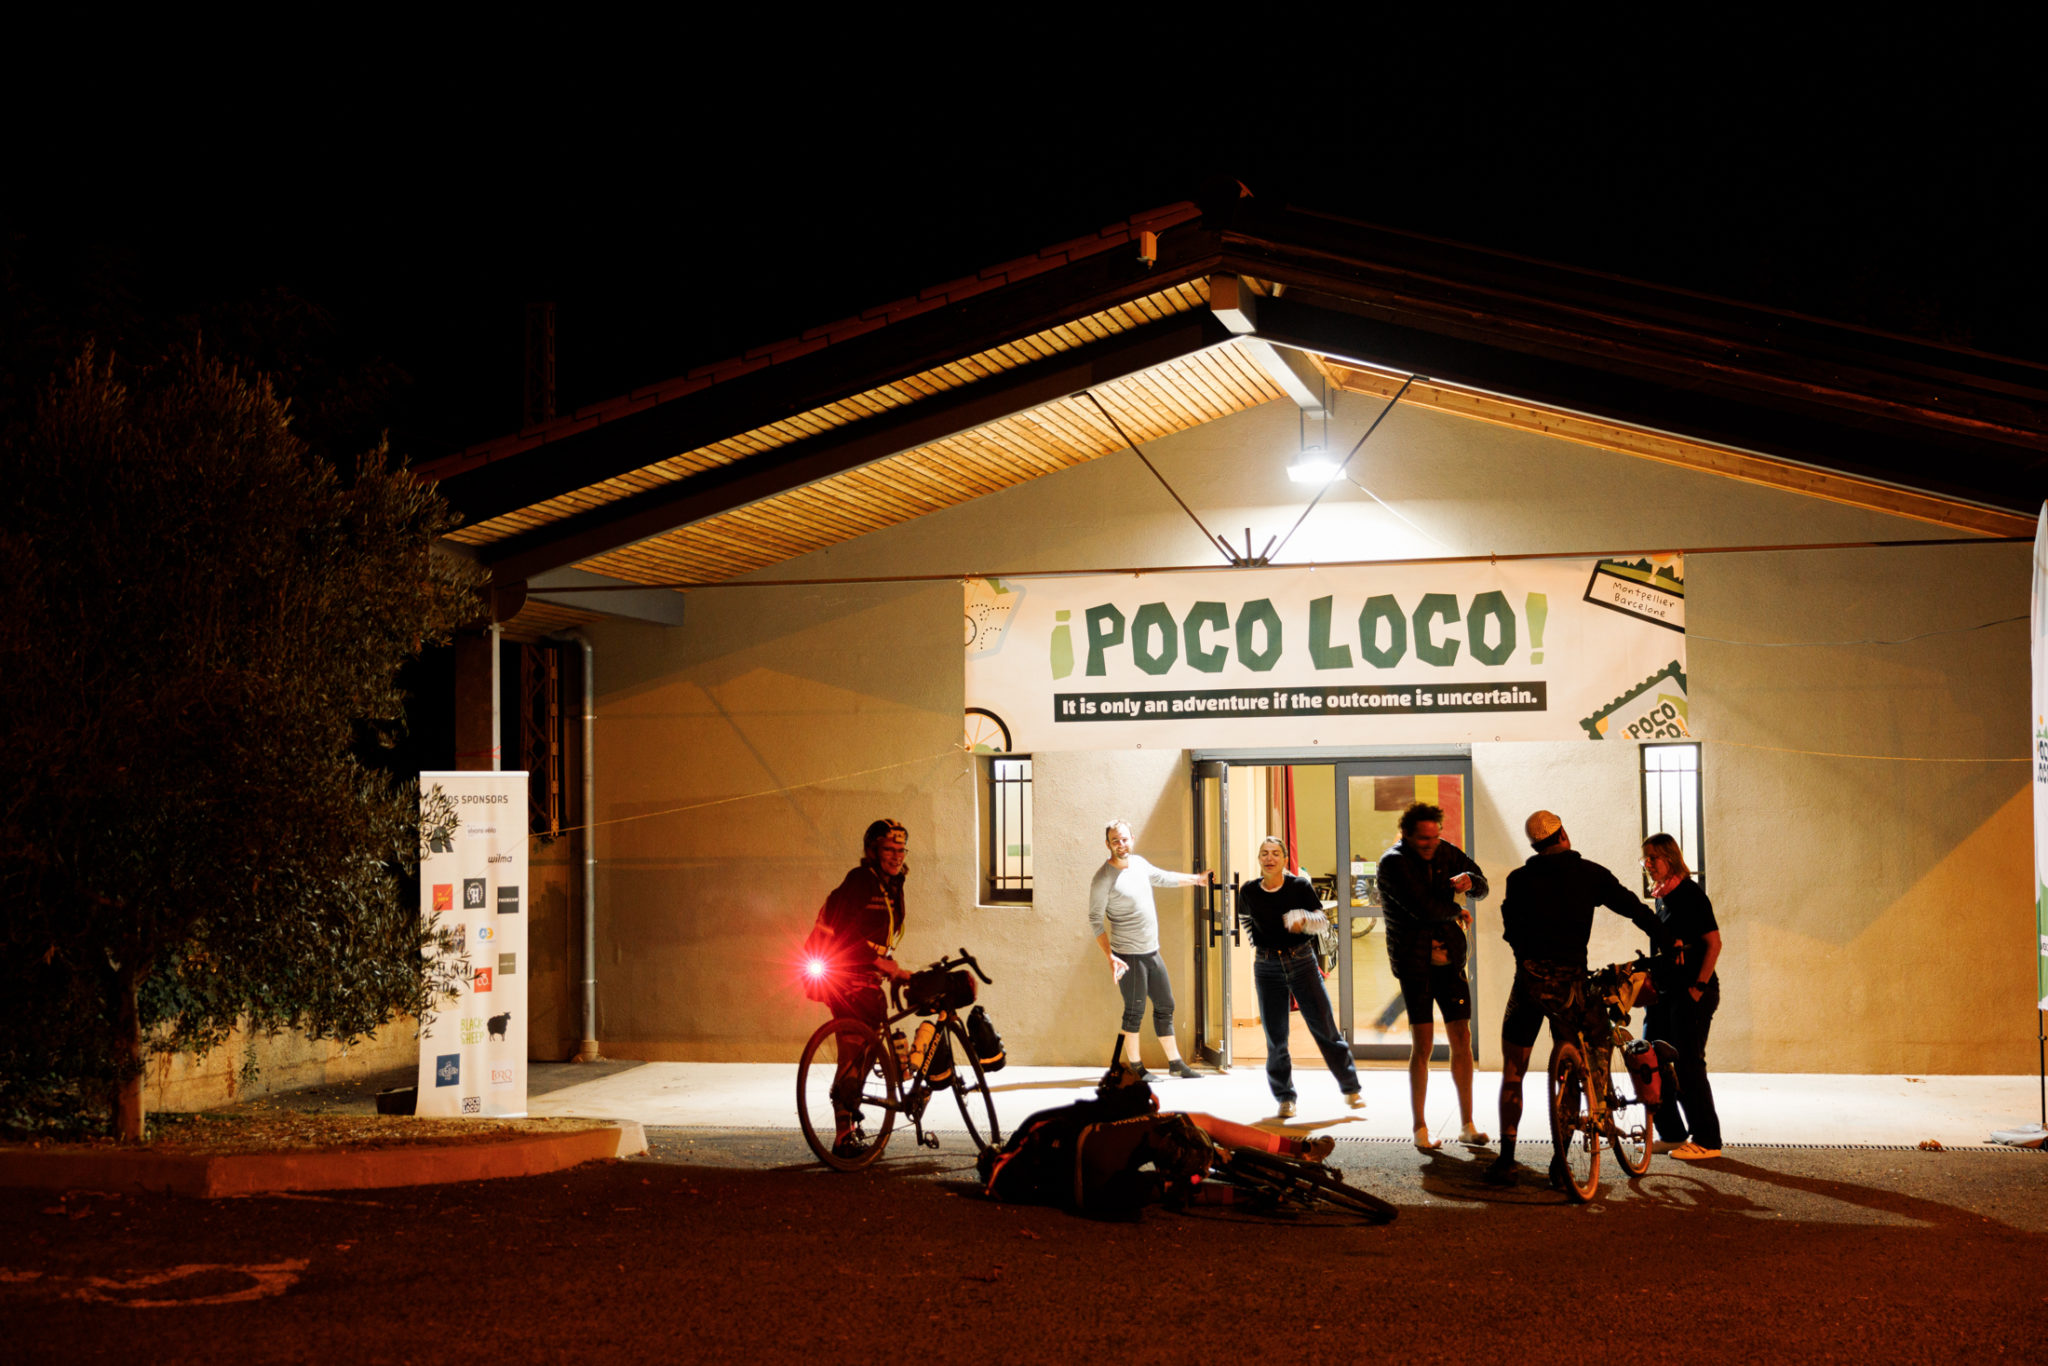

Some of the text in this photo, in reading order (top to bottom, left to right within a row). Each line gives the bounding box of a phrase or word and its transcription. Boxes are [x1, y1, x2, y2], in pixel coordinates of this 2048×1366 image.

[1612, 581, 1675, 608] Montpellier
[1614, 592, 1666, 618] Barcelone
[1308, 589, 1548, 670] LOCO!
[1062, 686, 1538, 717] It is only an adventure if the outcome is uncertain.
[461, 794, 509, 805] SPONSORS
